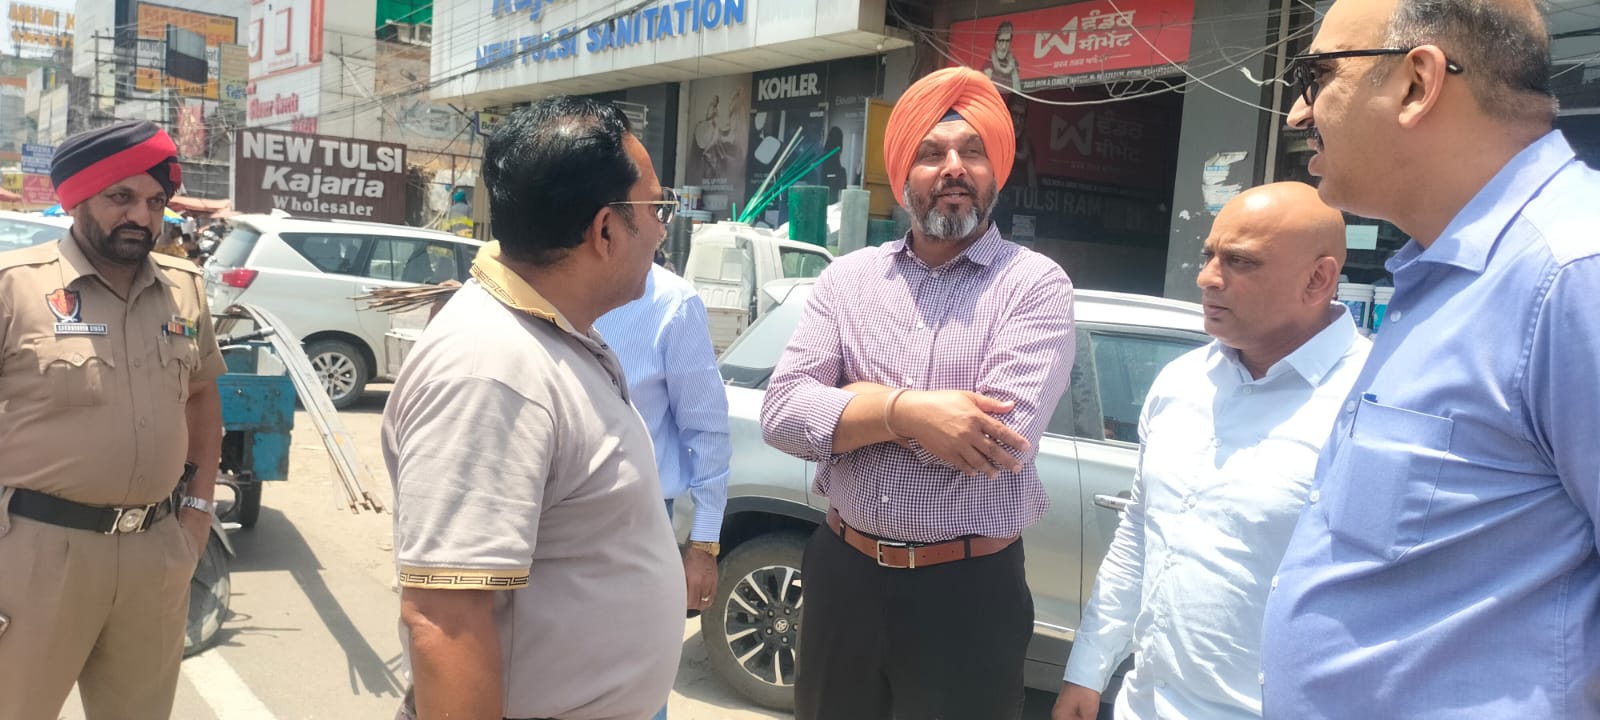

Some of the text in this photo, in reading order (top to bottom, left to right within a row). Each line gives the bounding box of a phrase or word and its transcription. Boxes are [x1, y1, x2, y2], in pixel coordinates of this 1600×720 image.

[518, 26, 579, 65] TULSI
[586, 0, 747, 54] SANITATION
[242, 131, 402, 173] NEW TULSI
[262, 165, 384, 200] Kajaria
[272, 195, 375, 217] Wholesaler
